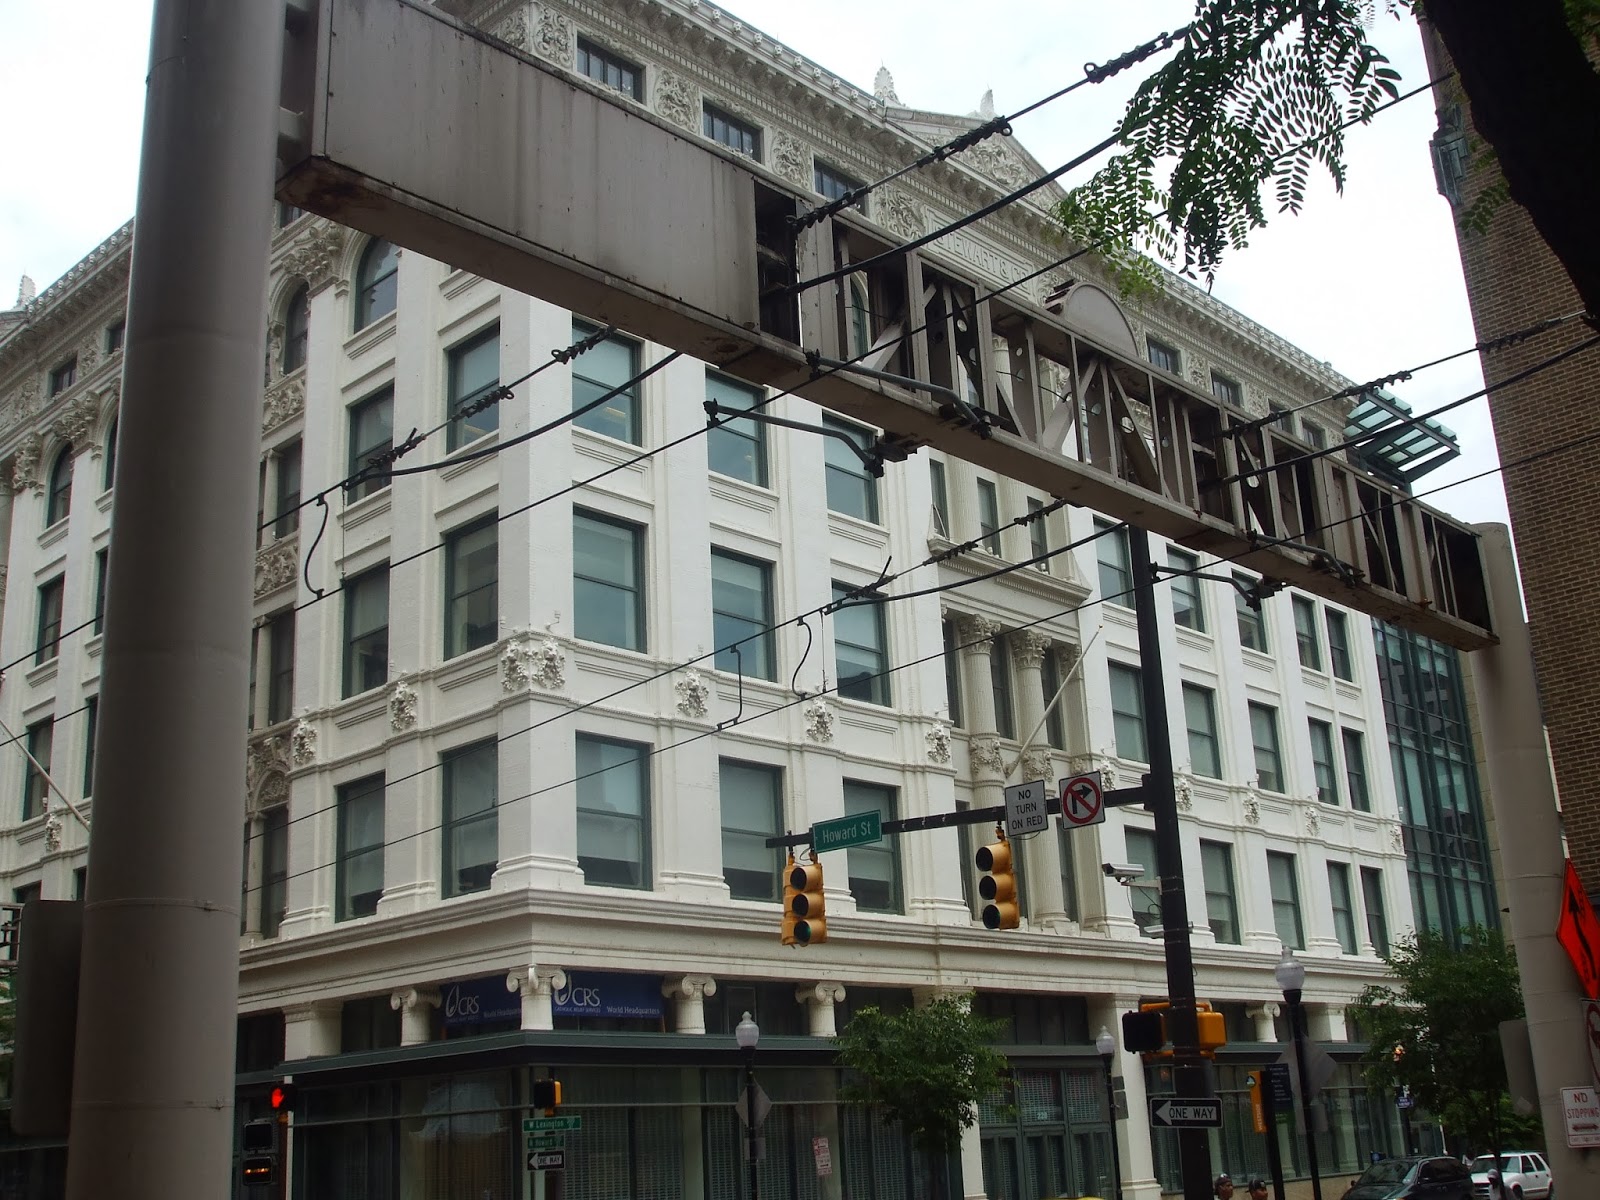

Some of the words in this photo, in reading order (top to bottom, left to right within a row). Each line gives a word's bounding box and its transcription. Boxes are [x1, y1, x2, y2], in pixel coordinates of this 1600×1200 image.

[934, 225, 998, 273] STEWART
[1000, 260, 1010, 280] &
[1018, 789, 1031, 800] NO
[1015, 802, 1037, 814] TURN
[1011, 819, 1023, 830] ON
[1026, 815, 1043, 827] RED
[822, 824, 857, 843] Howard
[860, 821, 871, 836] St
[572, 987, 601, 1007] CRS
[458, 996, 480, 1015] CRS
[606, 1006, 623, 1014] World
[624, 1006, 660, 1015] Headquarters
[1573, 1092, 1588, 1103] NO
[1168, 1107, 1188, 1119] ONE
[1193, 1107, 1214, 1119] WAY
[1566, 1107, 1600, 1119] STOPPING
[535, 1119, 564, 1130] Lexington
[549, 1155, 560, 1164] WAY
